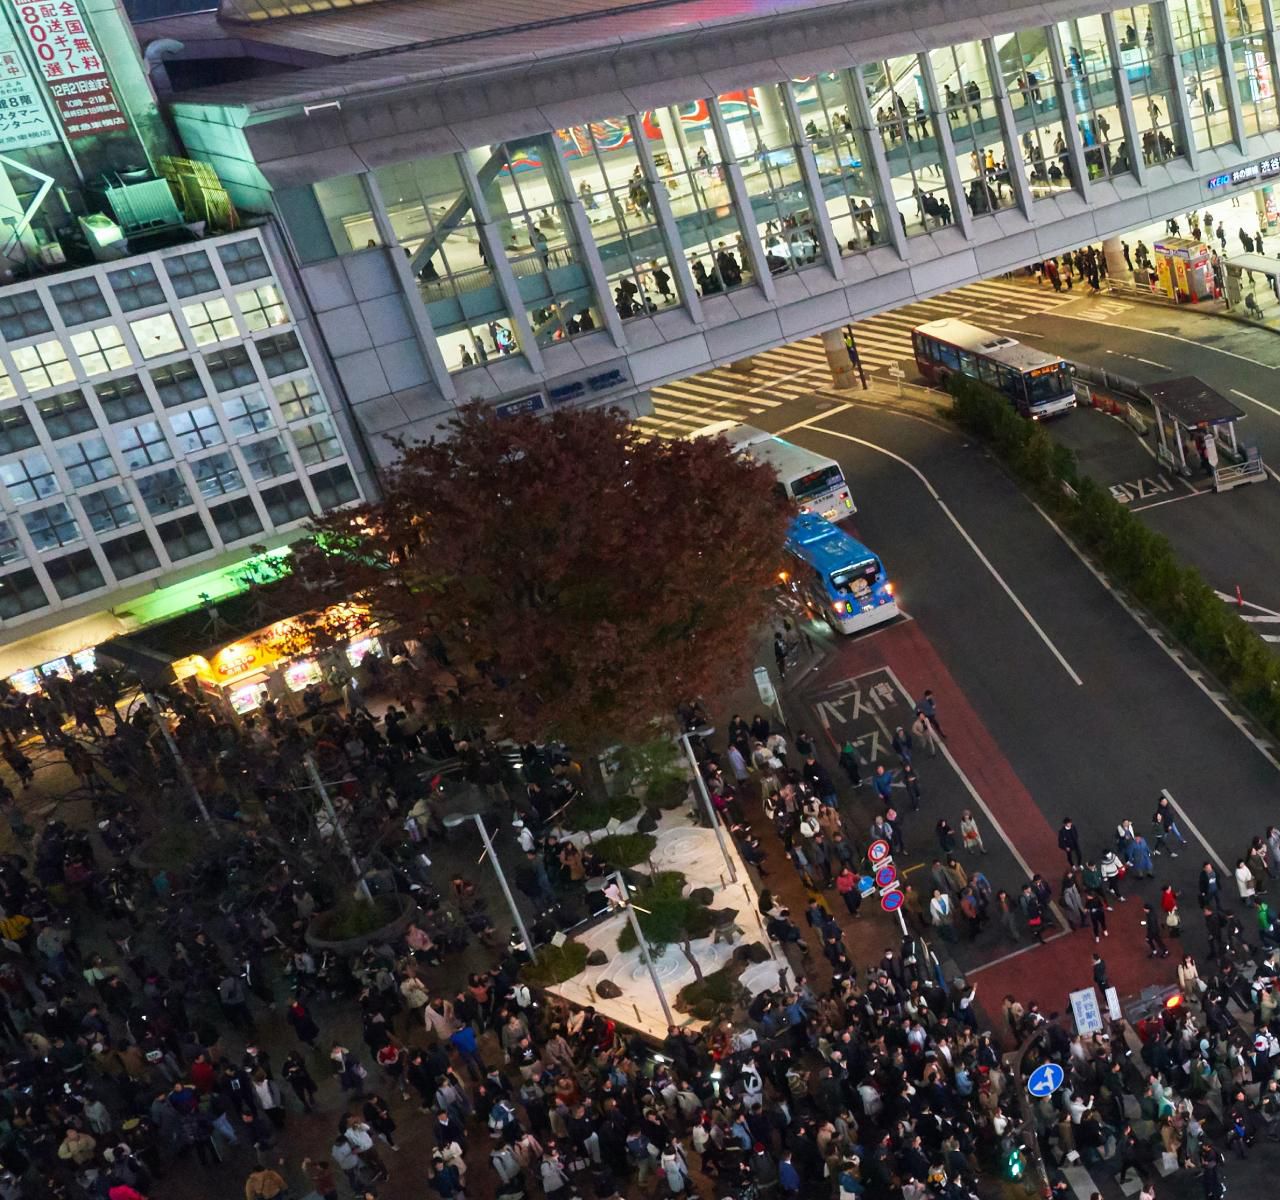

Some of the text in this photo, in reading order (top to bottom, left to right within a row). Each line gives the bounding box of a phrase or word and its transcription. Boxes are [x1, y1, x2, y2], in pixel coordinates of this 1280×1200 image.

[22, 6, 64, 77] 800選
[39, 3, 80, 73] 配送ギフト
[58, 1, 101, 70] 全国無料
[1208, 175, 1230, 188] KEIO
[817, 682, 897, 724] バス停
